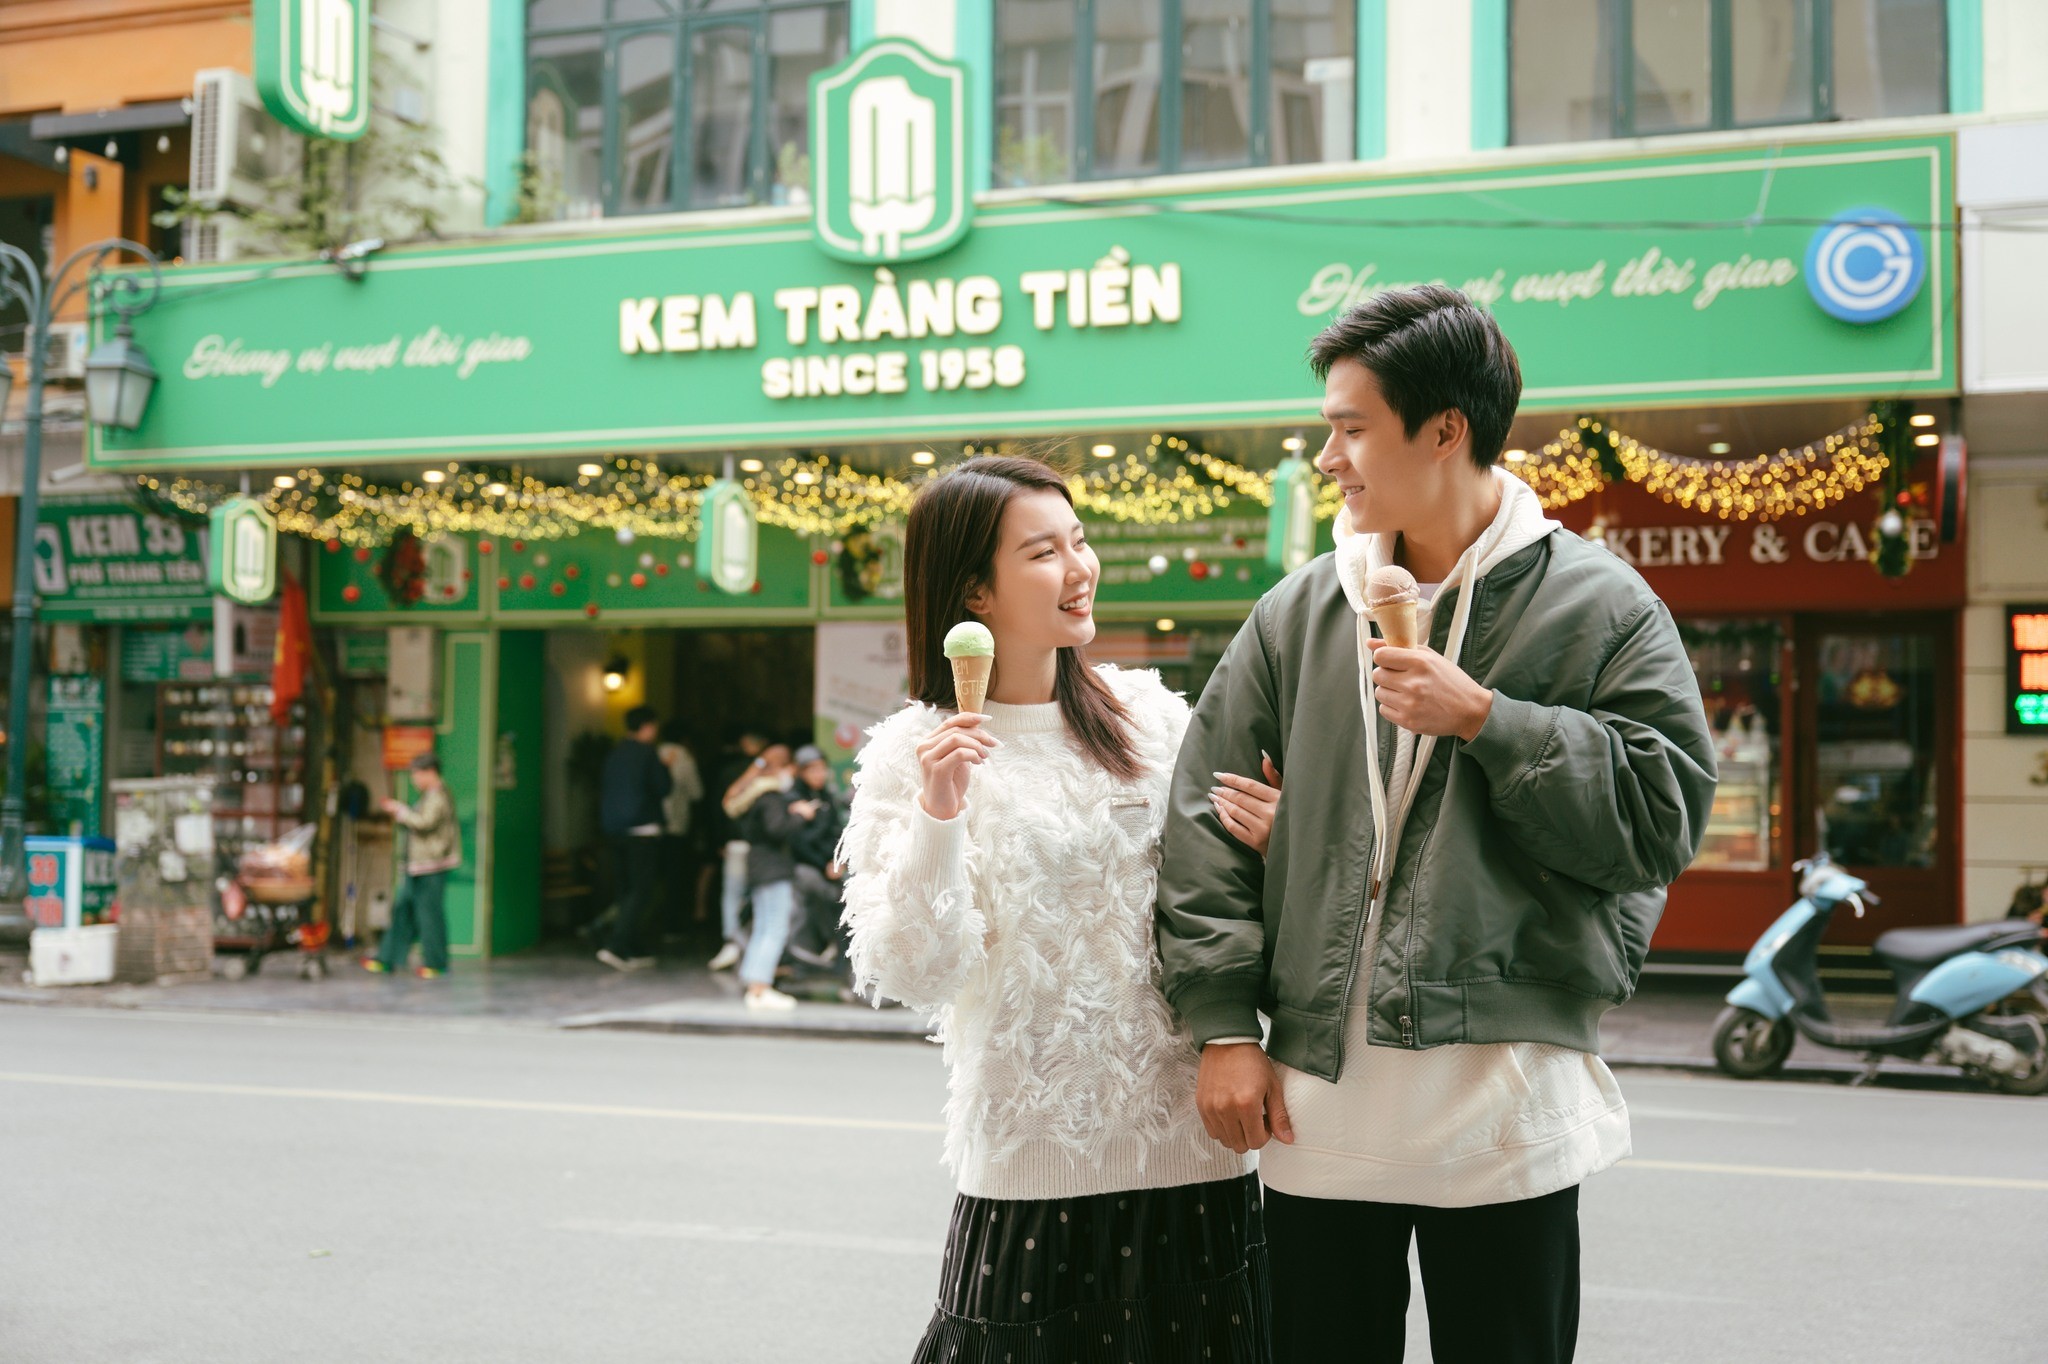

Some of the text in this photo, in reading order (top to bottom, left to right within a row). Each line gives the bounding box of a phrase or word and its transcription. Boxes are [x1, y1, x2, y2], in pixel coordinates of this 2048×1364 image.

[619, 245, 1182, 354] KEM TRÀNG TIỀN
[1692, 253, 1799, 311] gian
[761, 344, 1027, 400] SINCE 1958
[68, 514, 139, 557] KEM
[1606, 518, 1939, 568] KERY & CAE
